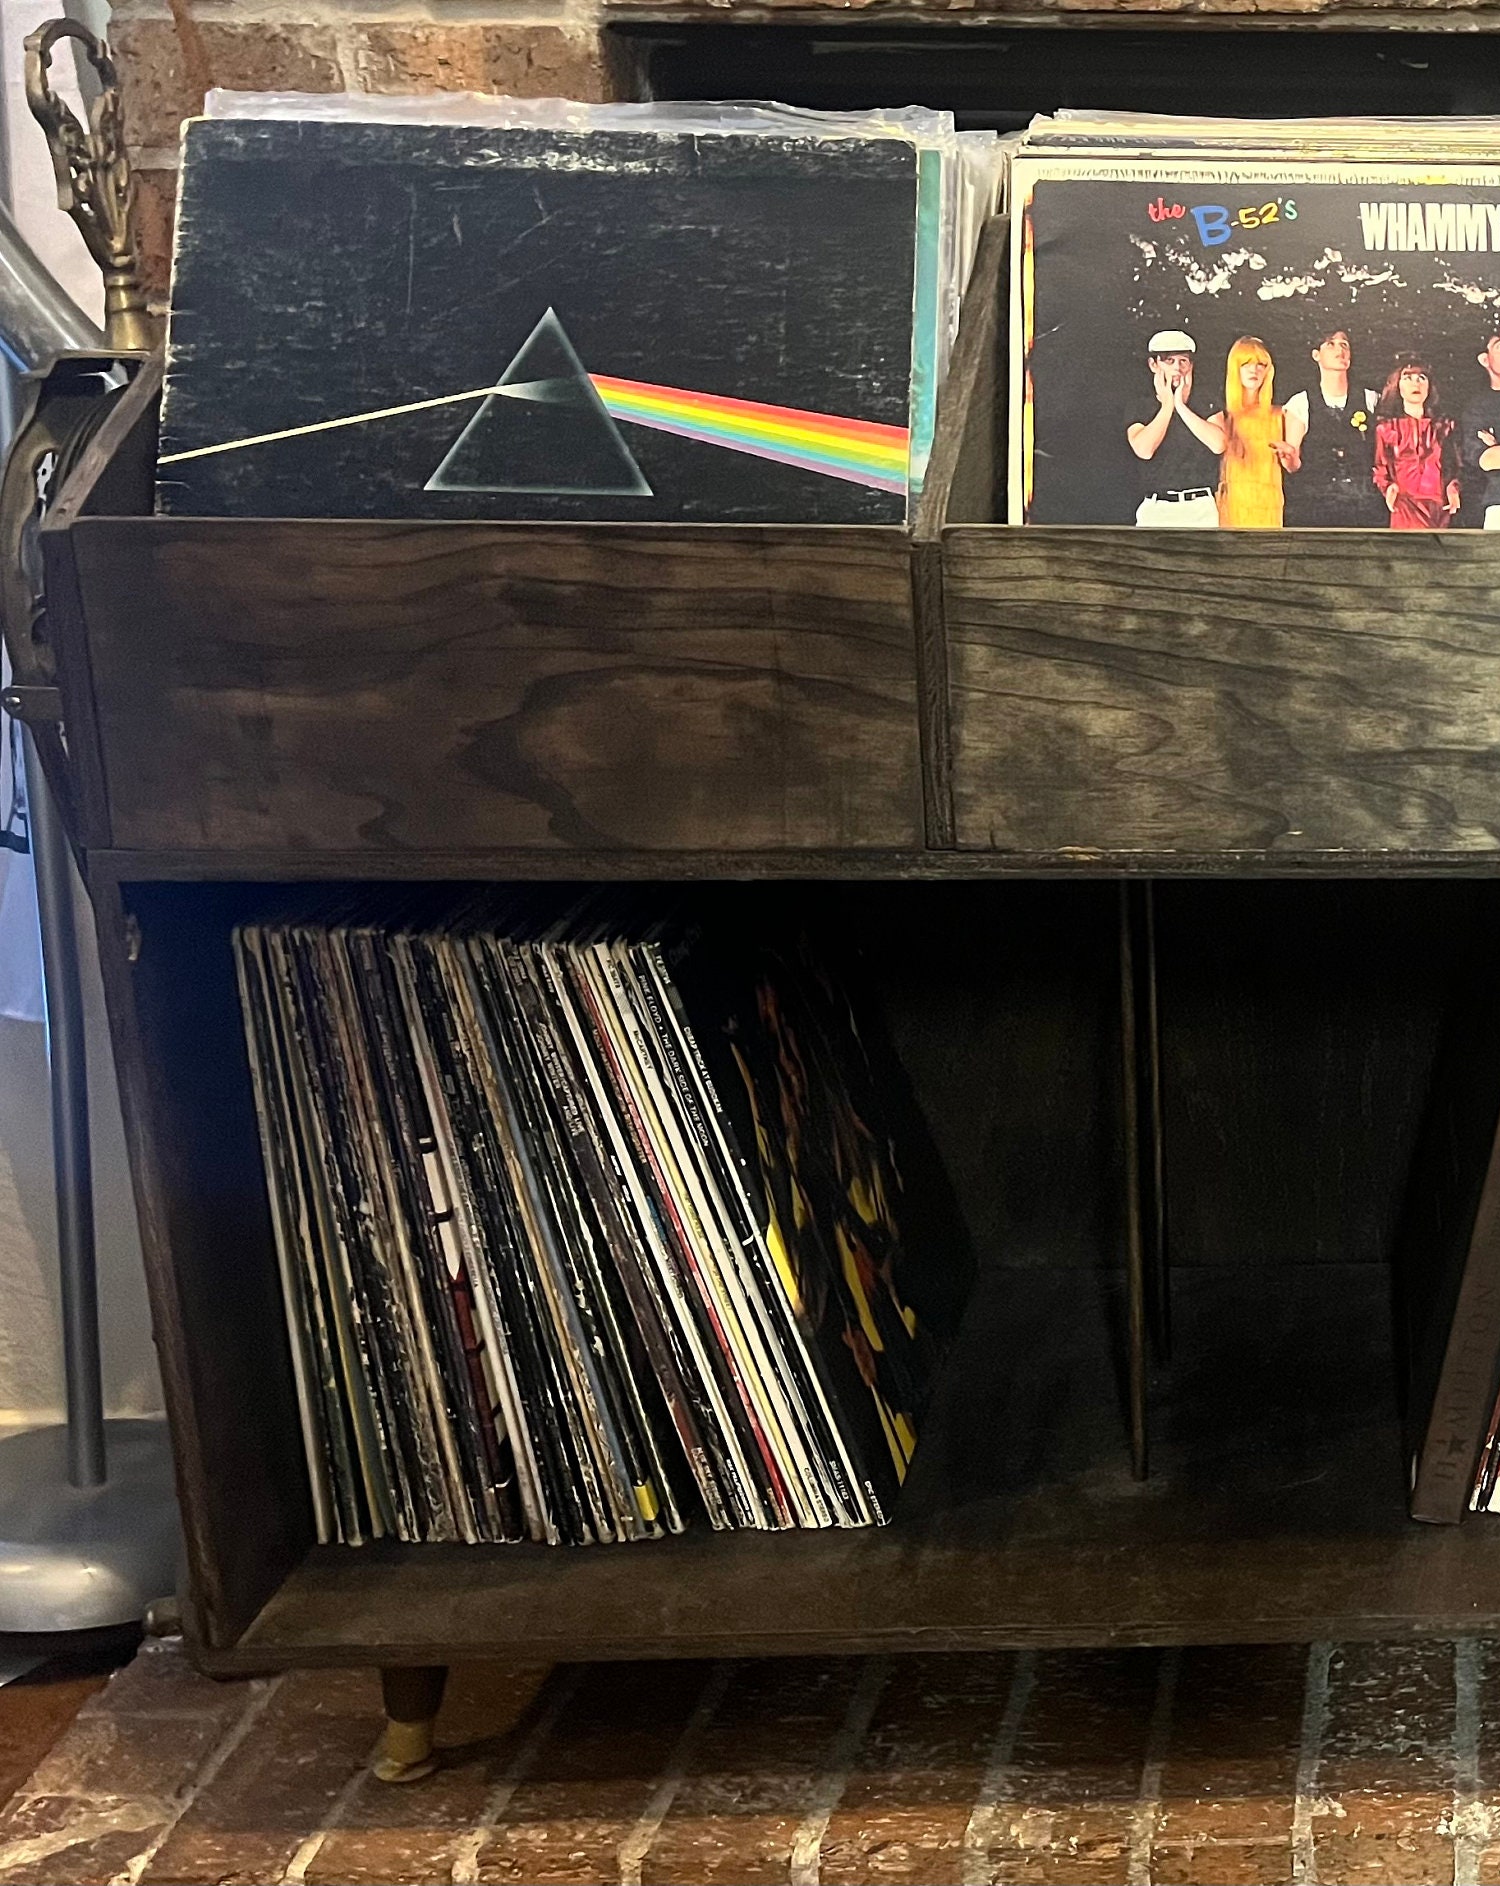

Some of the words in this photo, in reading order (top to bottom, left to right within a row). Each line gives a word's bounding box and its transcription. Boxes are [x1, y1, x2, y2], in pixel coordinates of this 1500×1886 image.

[1148, 198, 1185, 222] the
[1190, 197, 1297, 247] B-52's
[631, 1029, 654, 1070] McCARTNEY
[682, 1025, 697, 1049] CHEAP
[637, 973, 651, 994] PINK
[645, 994, 663, 1024] FLOYD
[661, 1032, 672, 1048] THE
[667, 1049, 682, 1073] DARK
[676, 1073, 689, 1092] SIDE
[684, 1092, 694, 1104] OF
[689, 1105, 701, 1121] THE
[695, 1121, 711, 1147] MOON
[692, 1049, 705, 1070] TRICK
[700, 1069, 710, 1080] AT
[704, 1079, 723, 1114] BUDOKAN
